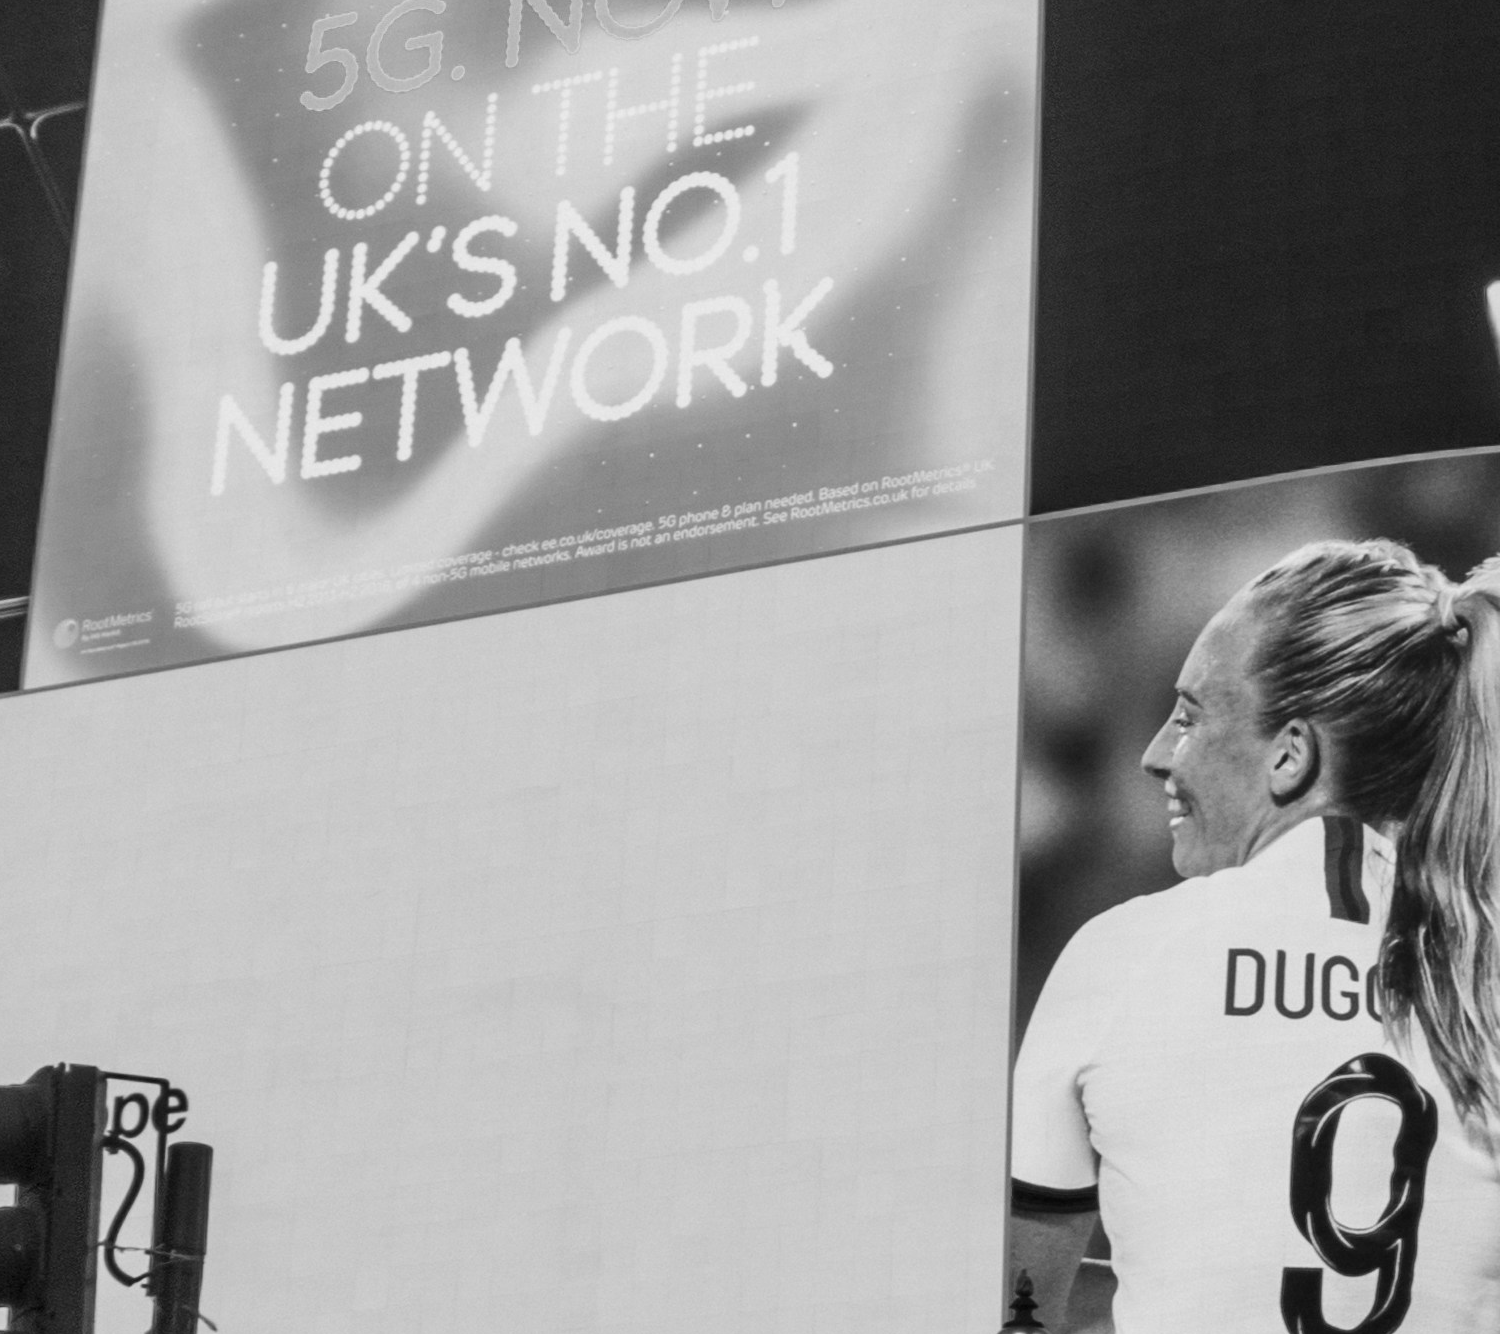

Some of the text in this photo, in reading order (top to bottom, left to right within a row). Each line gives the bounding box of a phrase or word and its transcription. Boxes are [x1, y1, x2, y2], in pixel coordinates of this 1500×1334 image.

[319, 35, 760, 221] ON THE
[258, 152, 800, 356] UK'S NO.1
[210, 277, 834, 496] NETWORK
[421, 565, 468, 586] non-5G
[469, 558, 511, 578] mobile
[512, 548, 572, 571] networks.
[574, 537, 616, 560] Award
[617, 538, 629, 552] is
[630, 534, 652, 550] not
[654, 531, 672, 545] an
[672, 515, 759, 541] endorsement.
[762, 509, 788, 525] See
[789, 489, 909, 521] RootMetrics.co.uk
[910, 484, 931, 500] for
[437, 549, 493, 568] coverage
[502, 539, 540, 558] check
[658, 515, 677, 530] 5G
[678, 507, 720, 528] phone
[734, 500, 762, 519] plan
[764, 490, 816, 510] needed.
[818, 481, 860, 501] Based
[861, 480, 879, 495] on
